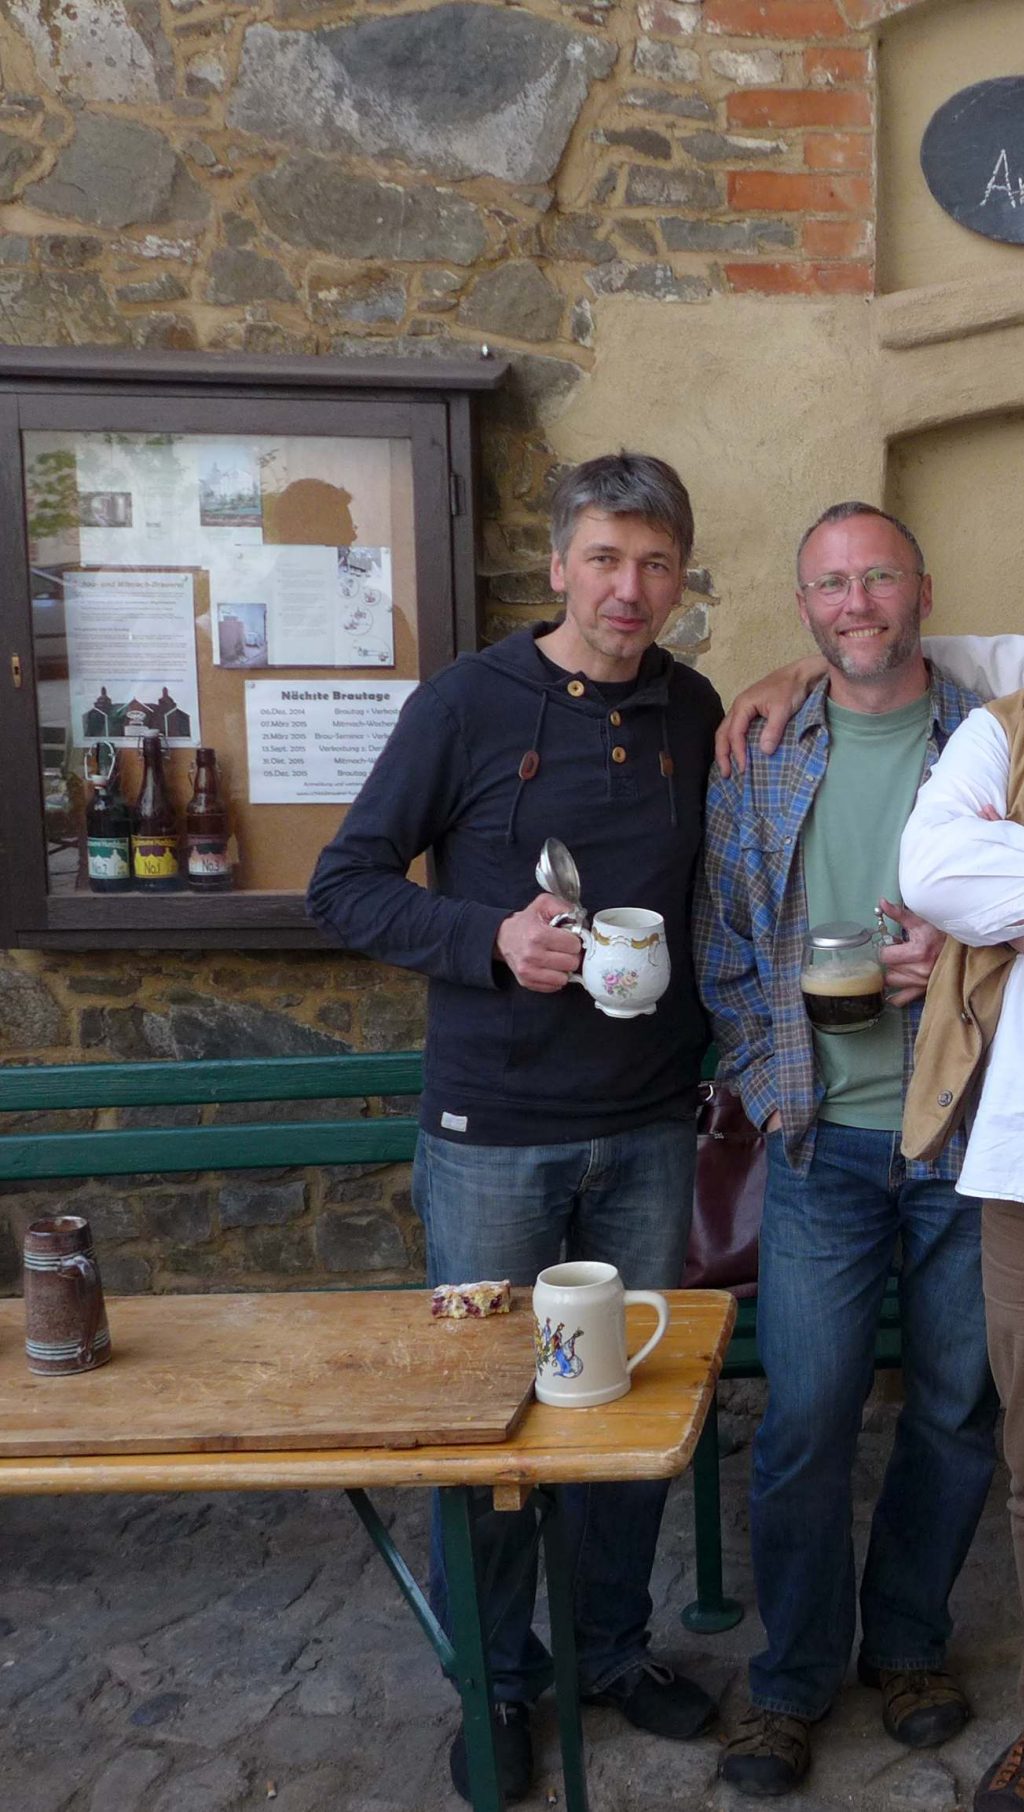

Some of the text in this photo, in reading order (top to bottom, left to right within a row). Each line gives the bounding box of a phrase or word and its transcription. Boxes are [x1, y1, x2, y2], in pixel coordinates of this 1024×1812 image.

[281, 690, 391, 702] Nächste Brautage
[334, 708, 365, 717] Brautag
[291, 720, 308, 728] 2015
[290, 732, 307, 740] 2015
[290, 745, 306, 753] 2015
[288, 757, 305, 765] 2015
[292, 769, 308, 778] 2015
[337, 769, 367, 778] Brautag
